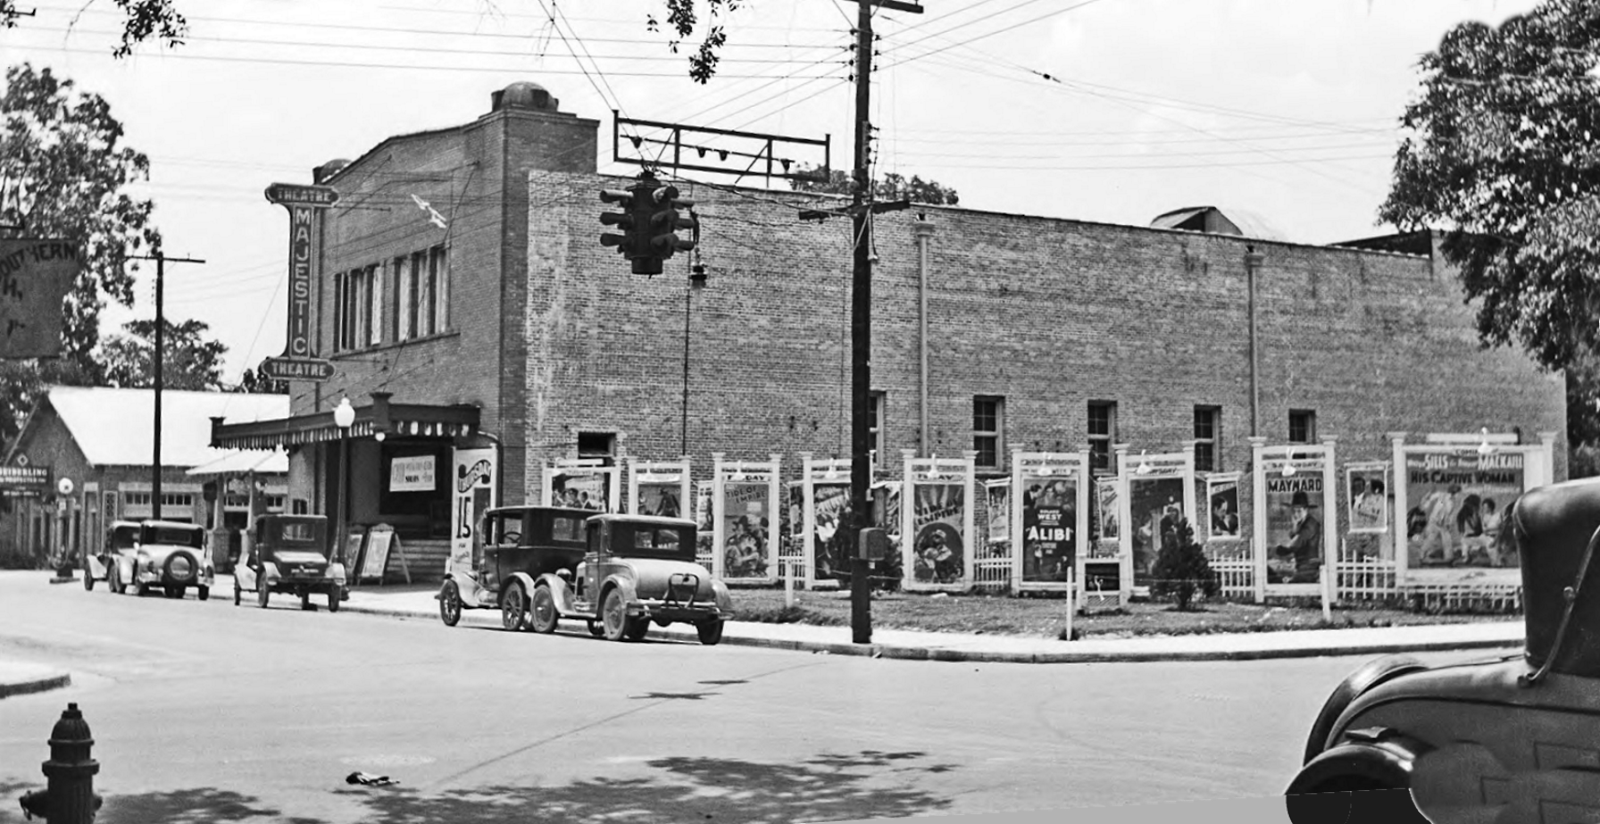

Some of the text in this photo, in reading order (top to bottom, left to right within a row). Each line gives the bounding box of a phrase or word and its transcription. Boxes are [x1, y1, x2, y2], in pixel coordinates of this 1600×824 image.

[277, 187, 332, 201] THEATRE
[0, 242, 77, 276] OUTHERN
[293, 208, 311, 353] MAJESTIC
[271, 361, 327, 376] THEATRE
[1424, 454, 1448, 470] SILLS
[1478, 454, 1523, 470] MACKAILL
[1411, 471, 1516, 484] HIS CAPTIVE WOMAN
[725, 485, 759, 498] TIDE OF
[1267, 479, 1322, 493] MAYNARD
[735, 490, 766, 504] EMPIRE
[456, 496, 471, 538] 15
[917, 507, 959, 526] EMPIRE
